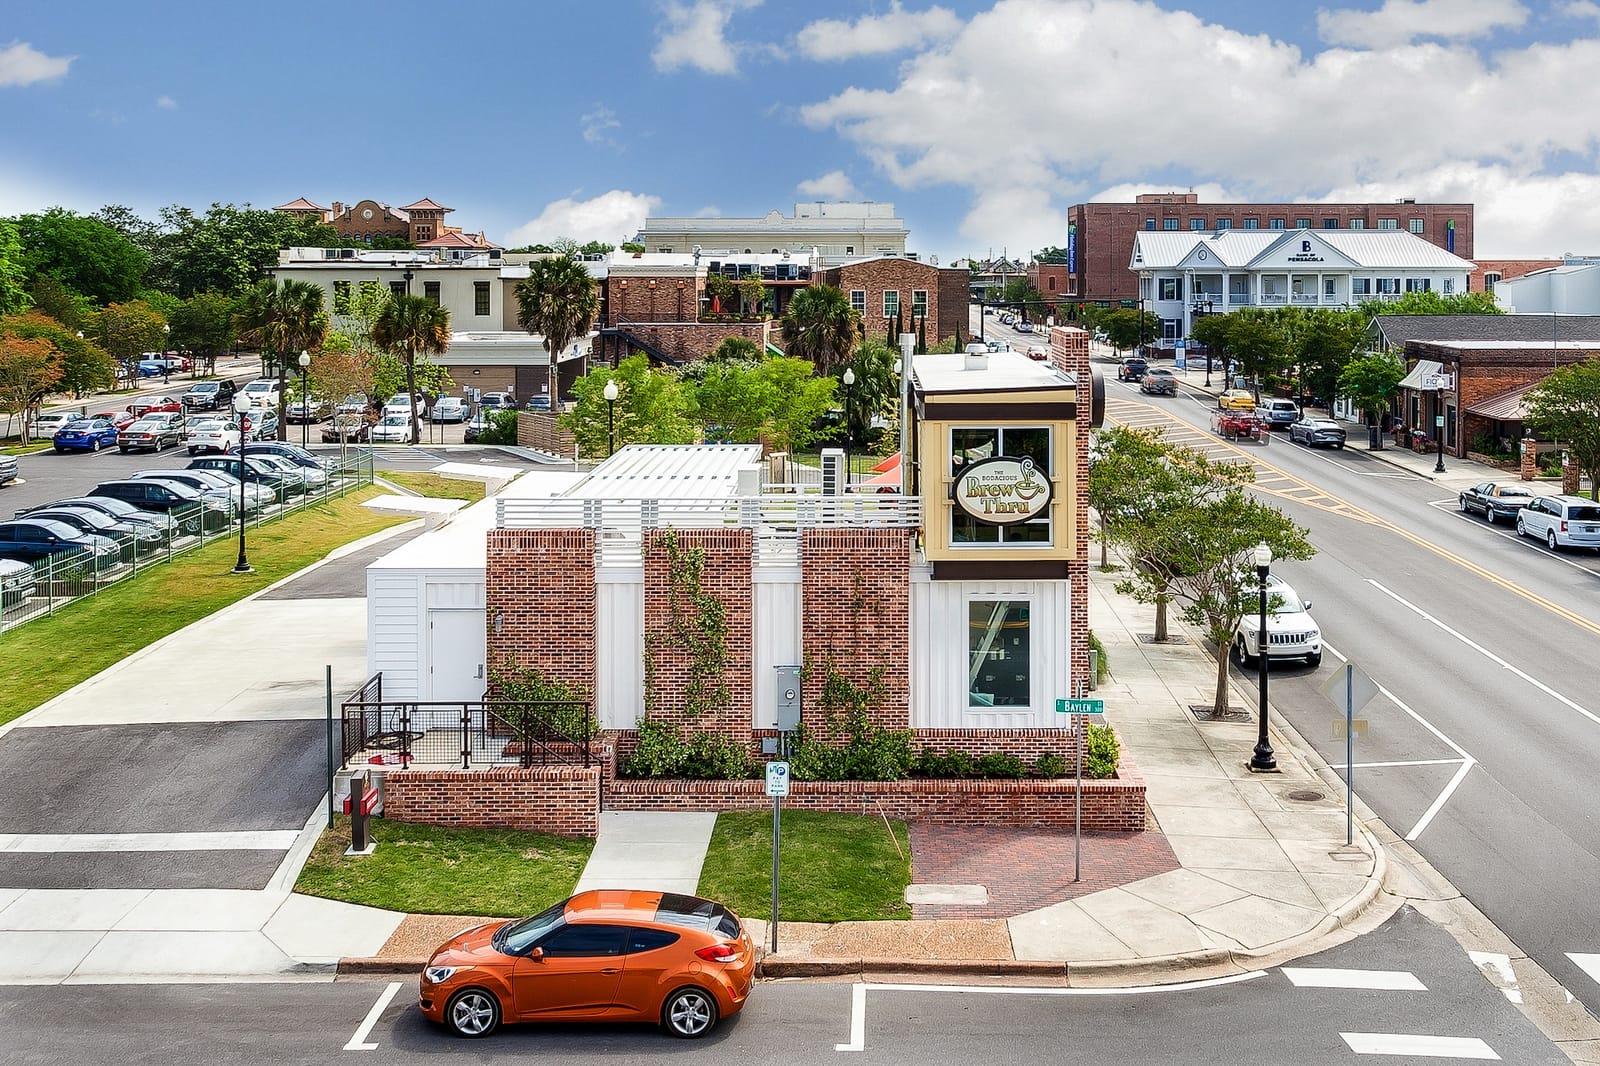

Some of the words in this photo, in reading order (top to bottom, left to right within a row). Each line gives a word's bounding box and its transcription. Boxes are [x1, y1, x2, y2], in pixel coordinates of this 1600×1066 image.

[1302, 240, 1312, 252] B
[965, 476, 1016, 498] Brew
[980, 497, 1030, 514] Thru
[1064, 700, 1092, 712] BAYLEN
